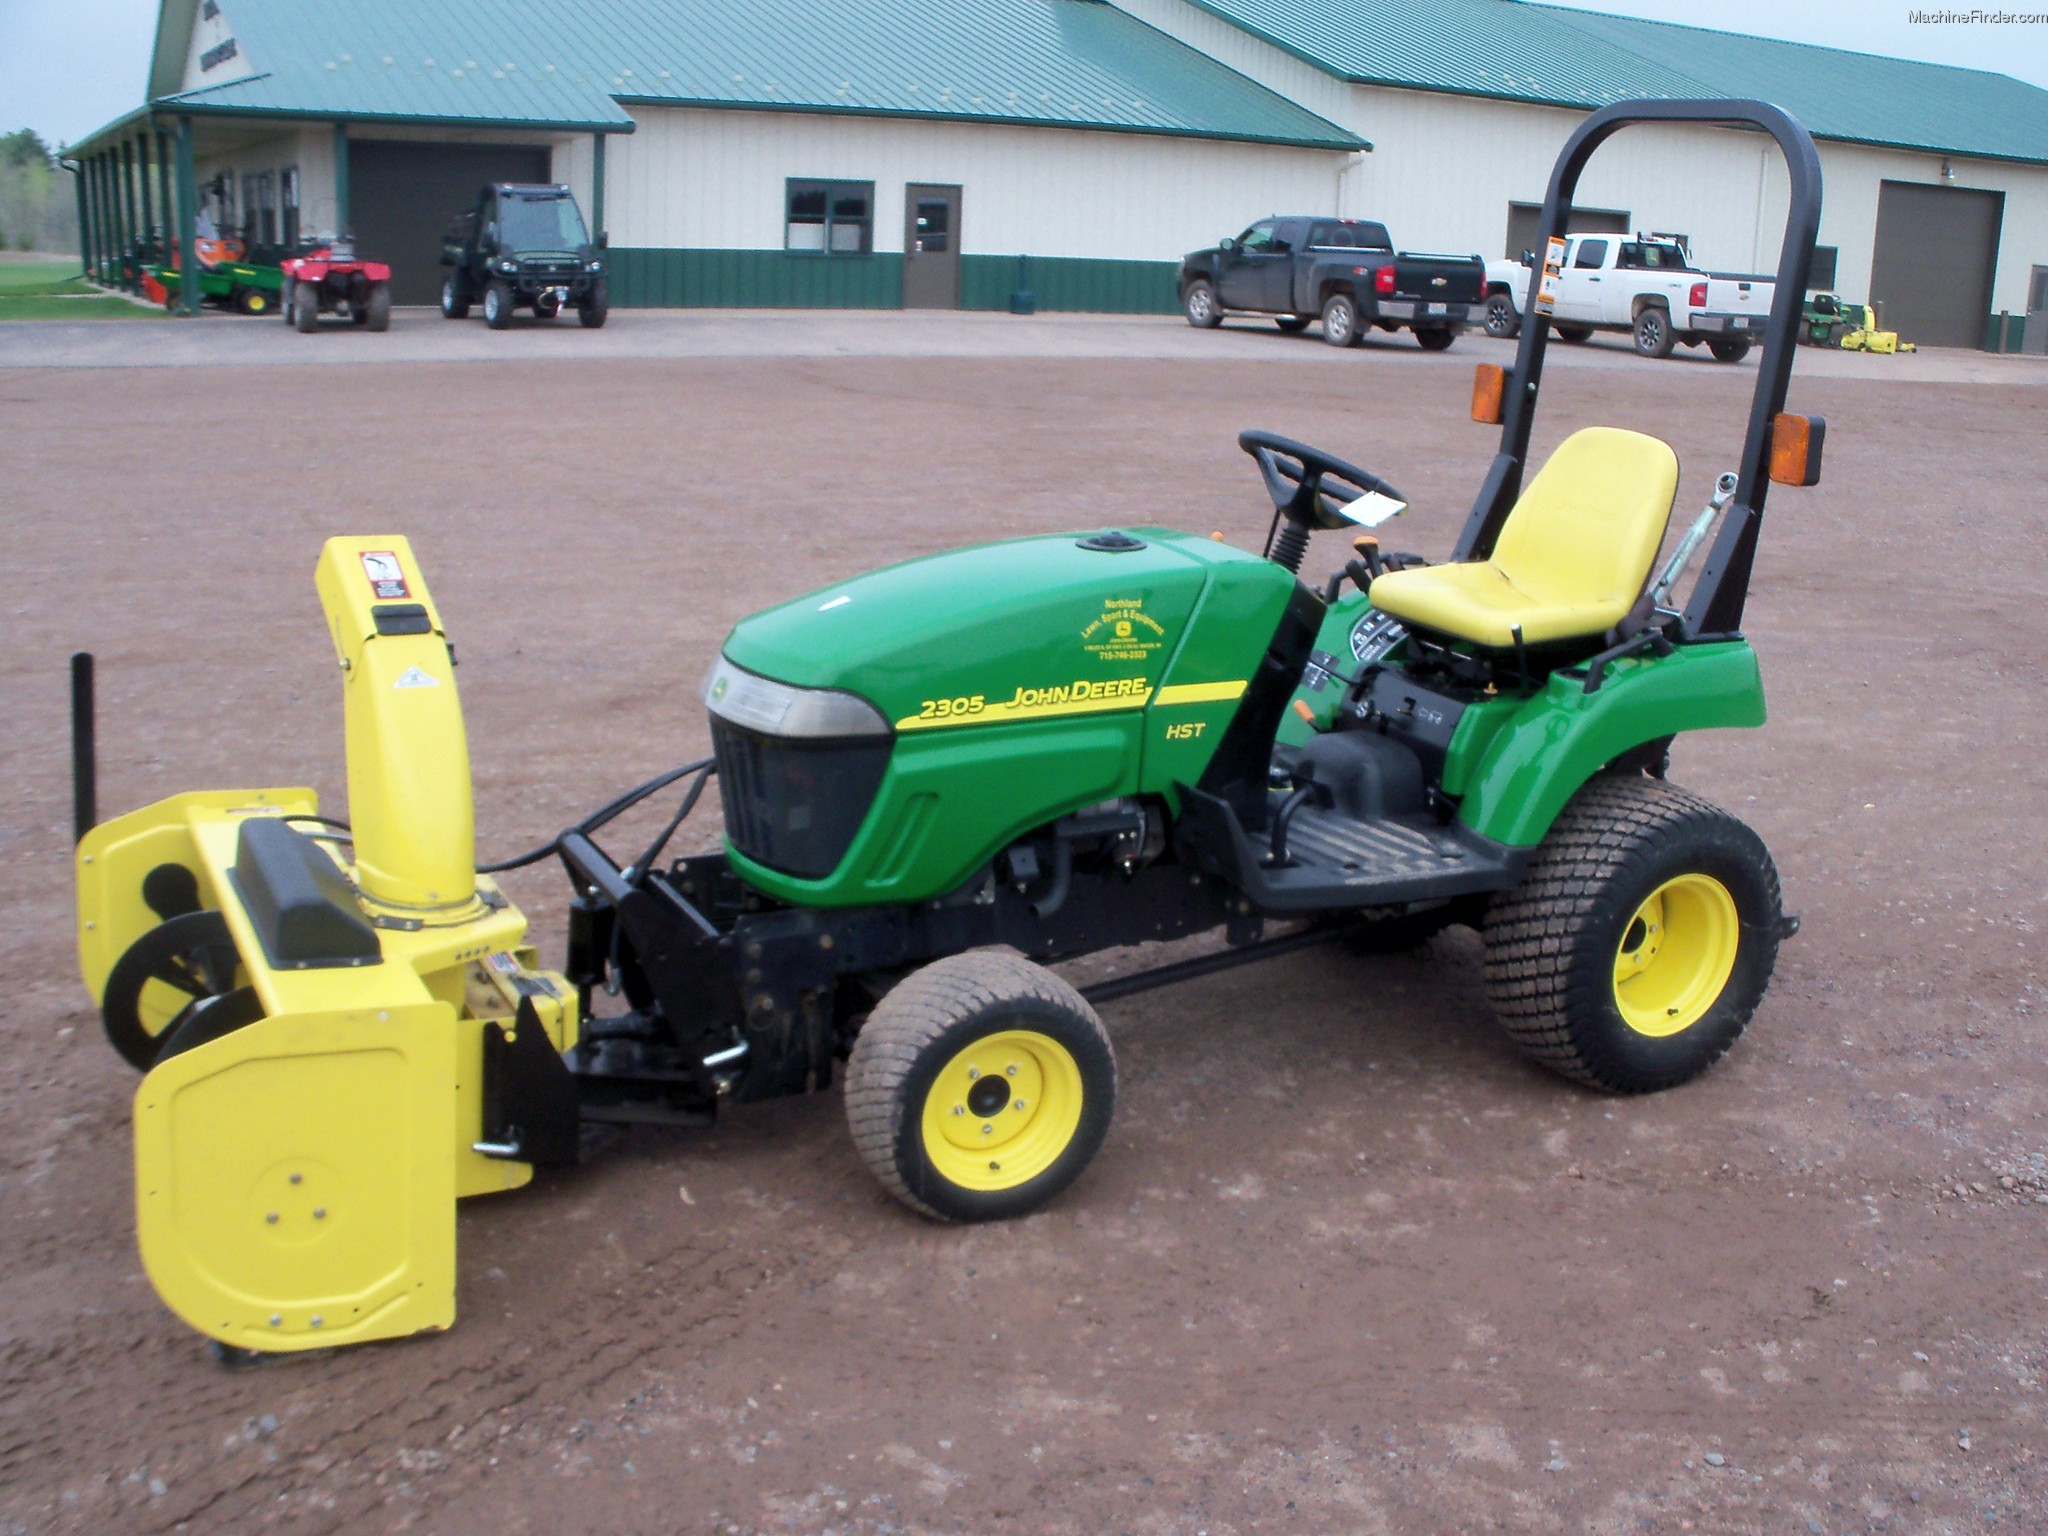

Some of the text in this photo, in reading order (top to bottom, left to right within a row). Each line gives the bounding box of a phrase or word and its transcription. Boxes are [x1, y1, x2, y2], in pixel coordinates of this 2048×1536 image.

[1104, 598, 1142, 609] Northland
[1101, 610, 1122, 623] Sport
[1122, 609, 1129, 618] &
[1129, 609, 1165, 636] Equipment
[920, 695, 985, 719] 2305
[1165, 722, 1206, 740] HST
